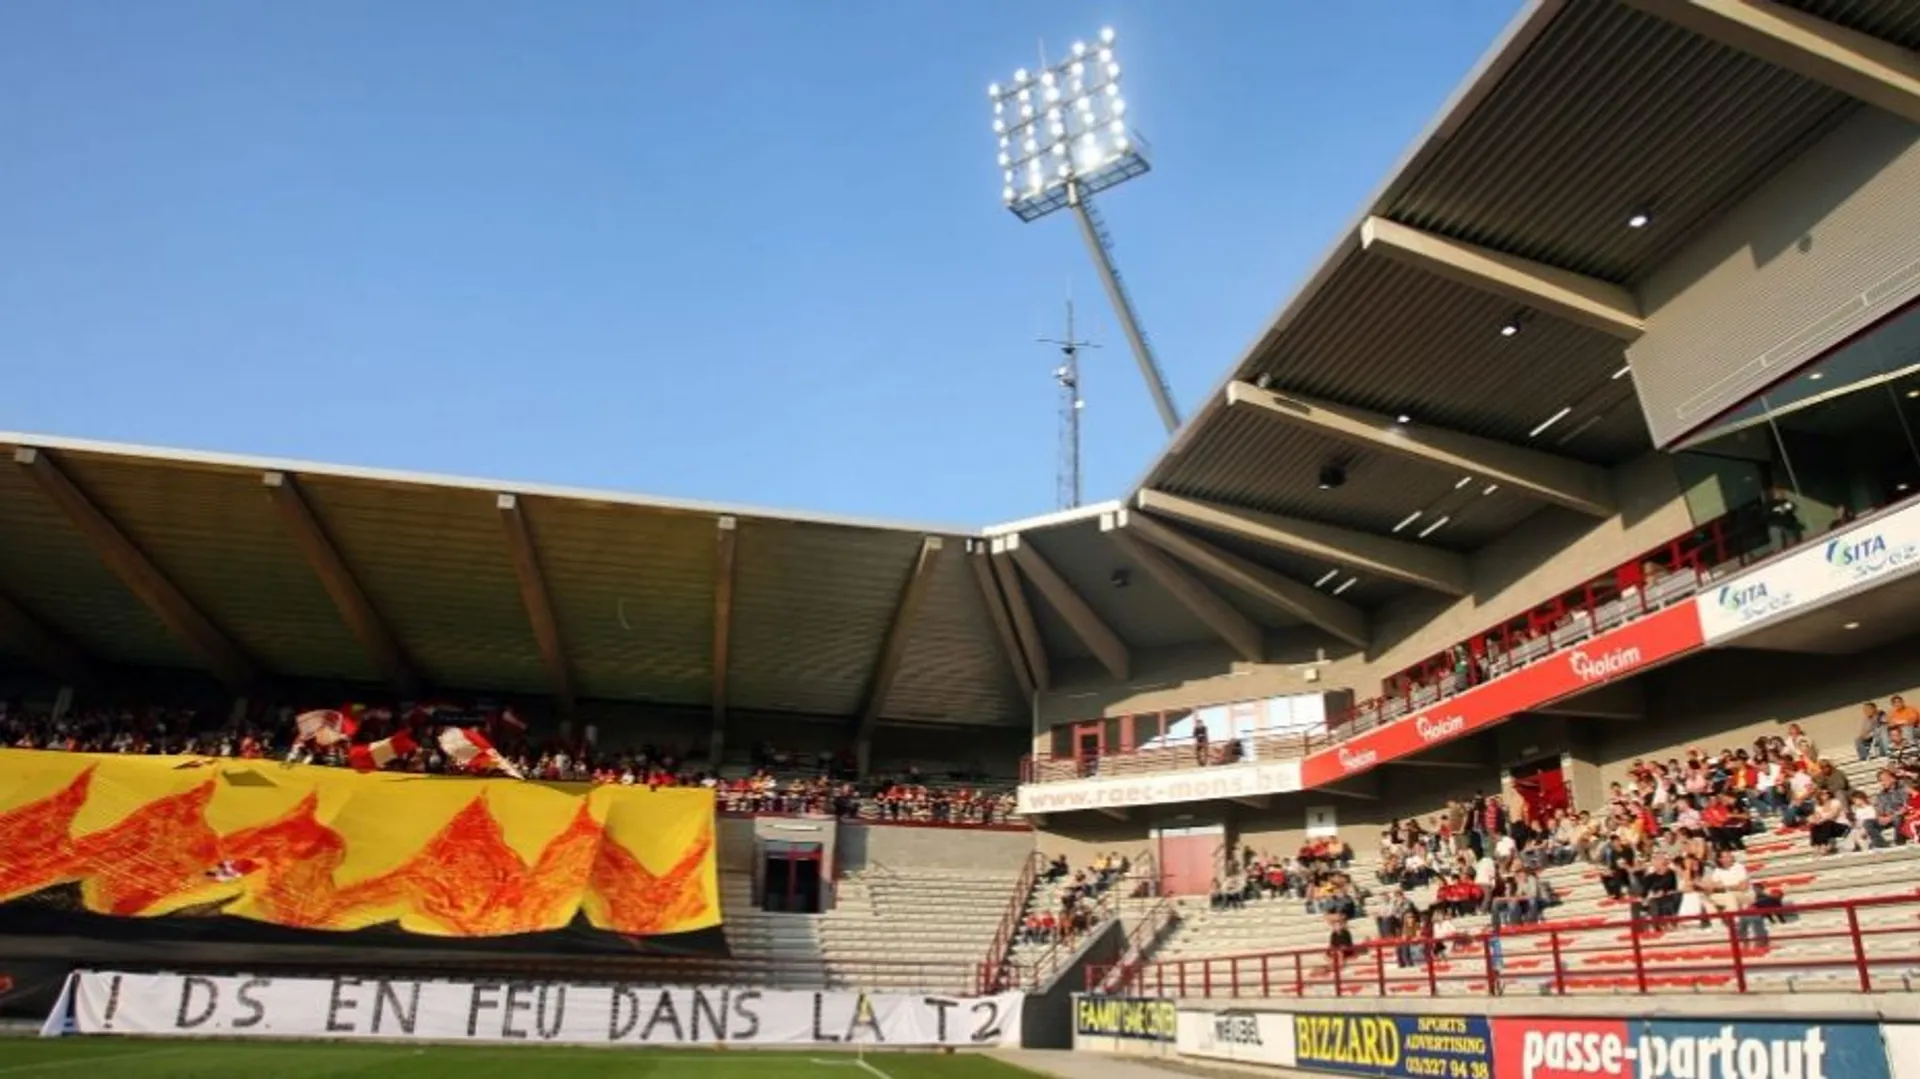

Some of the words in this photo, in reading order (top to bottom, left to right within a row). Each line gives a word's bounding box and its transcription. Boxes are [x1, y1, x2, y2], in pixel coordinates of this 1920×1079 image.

[1843, 535, 1886, 565] SITA
[1582, 646, 1641, 681] Holcim
[1029, 765, 1292, 808] www.raec-mons.be
[326, 977, 421, 1034] EN
[467, 982, 565, 1039] FEU
[609, 989, 760, 1040] DANS
[812, 993, 885, 1041] LA
[924, 998, 1001, 1042] T2
[1418, 1016, 1467, 1034] SPORTS
[1299, 1016, 1399, 1068] BIZZARD
[1404, 1033, 1486, 1055] ADVERTISING
[1522, 1025, 1826, 1079] passe-partout
